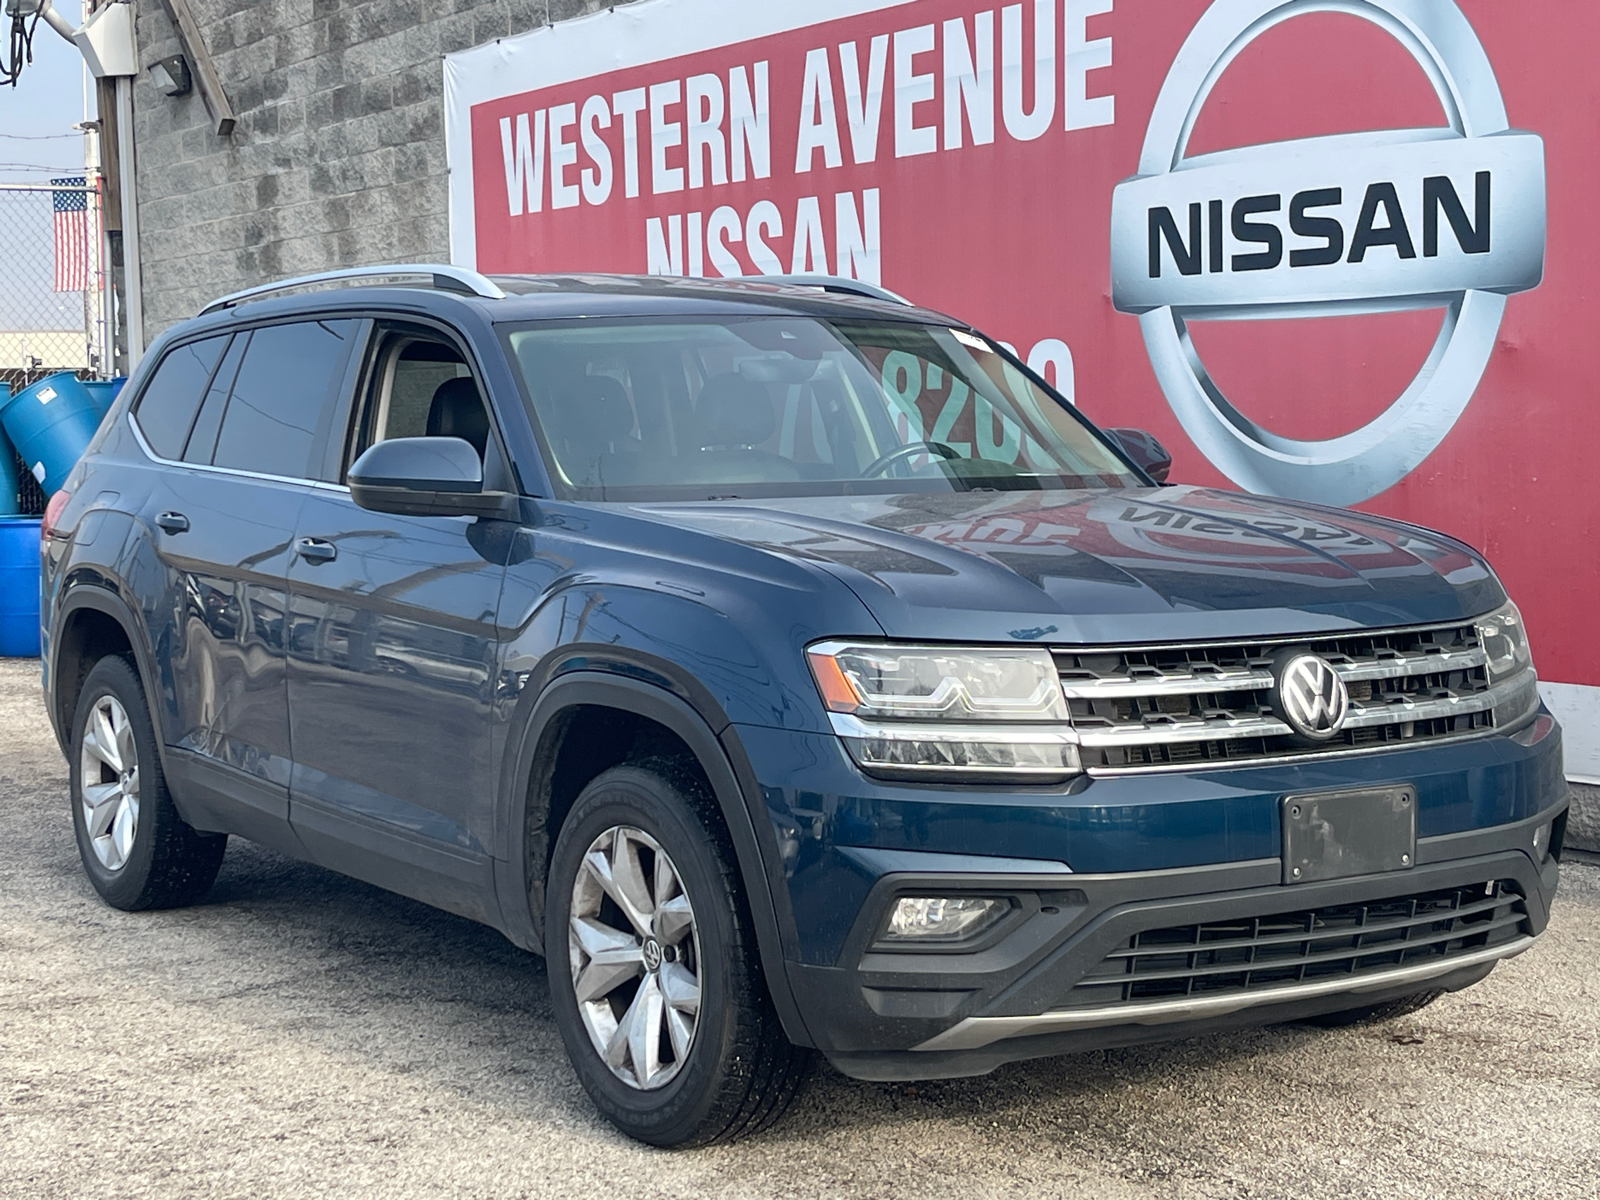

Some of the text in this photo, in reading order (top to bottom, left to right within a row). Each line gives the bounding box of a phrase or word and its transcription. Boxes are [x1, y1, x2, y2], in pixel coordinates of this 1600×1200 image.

[499, 0, 1115, 216] WESTERN AVENUE
[1148, 171, 1491, 278] NISSAN
